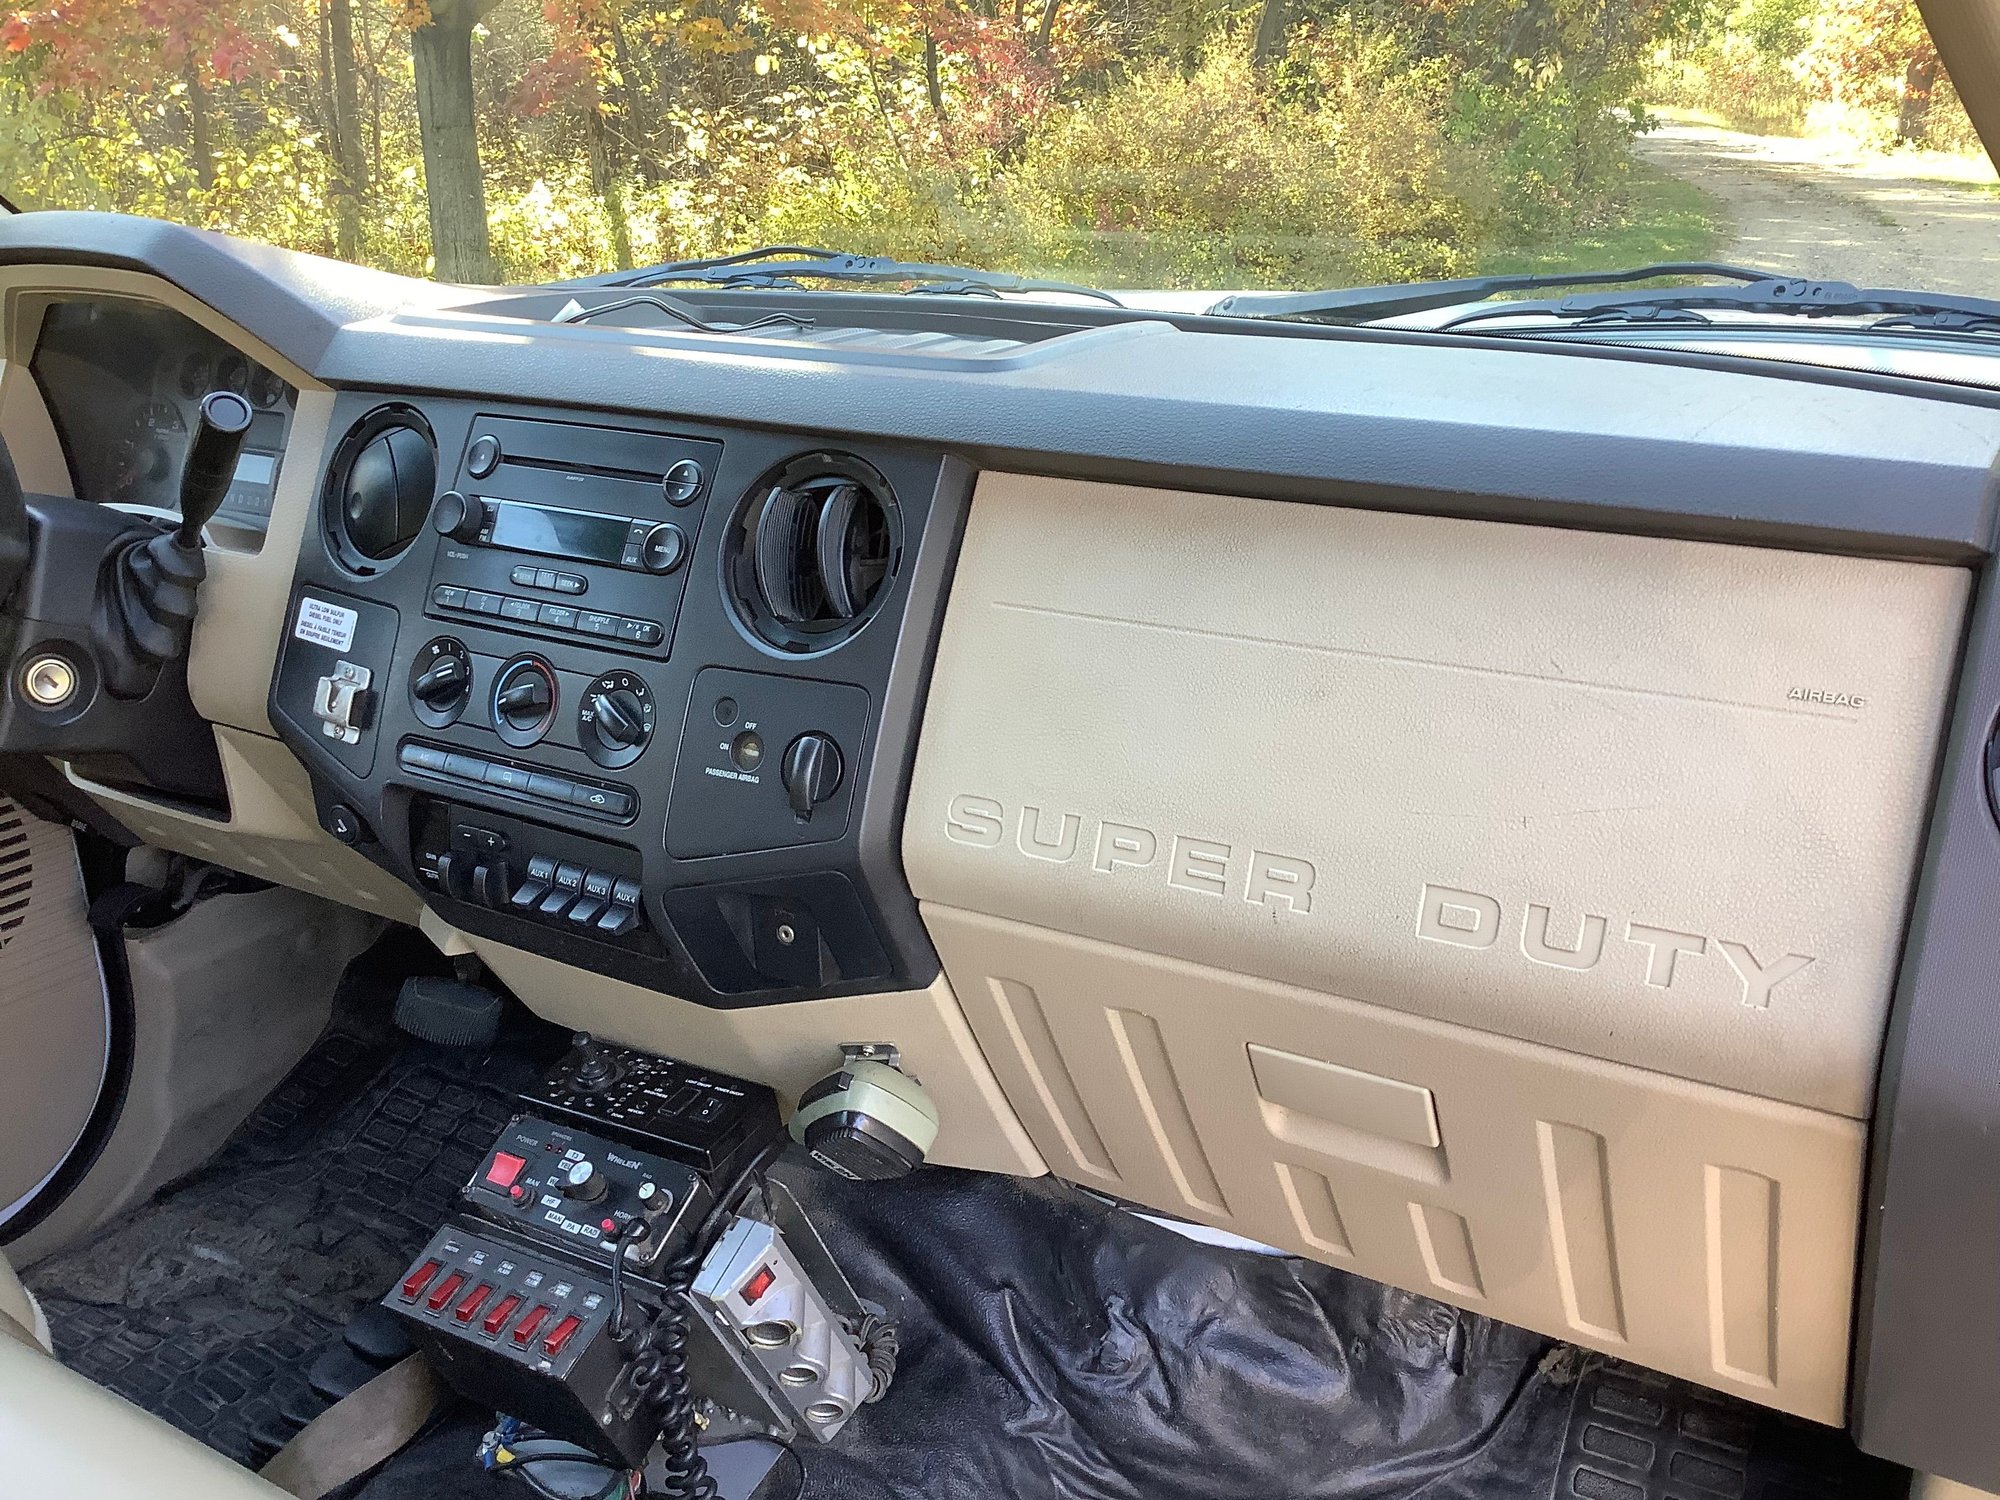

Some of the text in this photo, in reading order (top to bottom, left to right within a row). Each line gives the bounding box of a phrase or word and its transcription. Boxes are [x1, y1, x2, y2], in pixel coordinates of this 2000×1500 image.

[654, 545, 672, 554] MENU
[625, 556, 638, 564] AUX
[588, 615, 611, 625] SHUFFLE
[594, 623, 600, 631] 5
[635, 631, 642, 639] 6
[459, 650, 465, 660] 2
[465, 666, 470, 676] 3
[1786, 687, 1866, 709] AIRBAG
[581, 709, 595, 717] MAX
[744, 721, 758, 730] OFF
[719, 742, 730, 751] ON
[704, 767, 760, 784] PASSENGER AIRBAG
[530, 868, 545, 879] AUX
[559, 876, 572, 886] AUX
[587, 884, 601, 894] AUX
[616, 892, 631, 902] AUX
[944, 793, 1816, 1010] SUPER DUTY
[515, 1134, 539, 1147] POWER
[606, 1152, 641, 1170] WHELEN
[525, 1177, 541, 1187] MAN
[548, 1212, 563, 1222] MAN
[566, 1223, 576, 1231] PA
[583, 1226, 598, 1237] RAD
